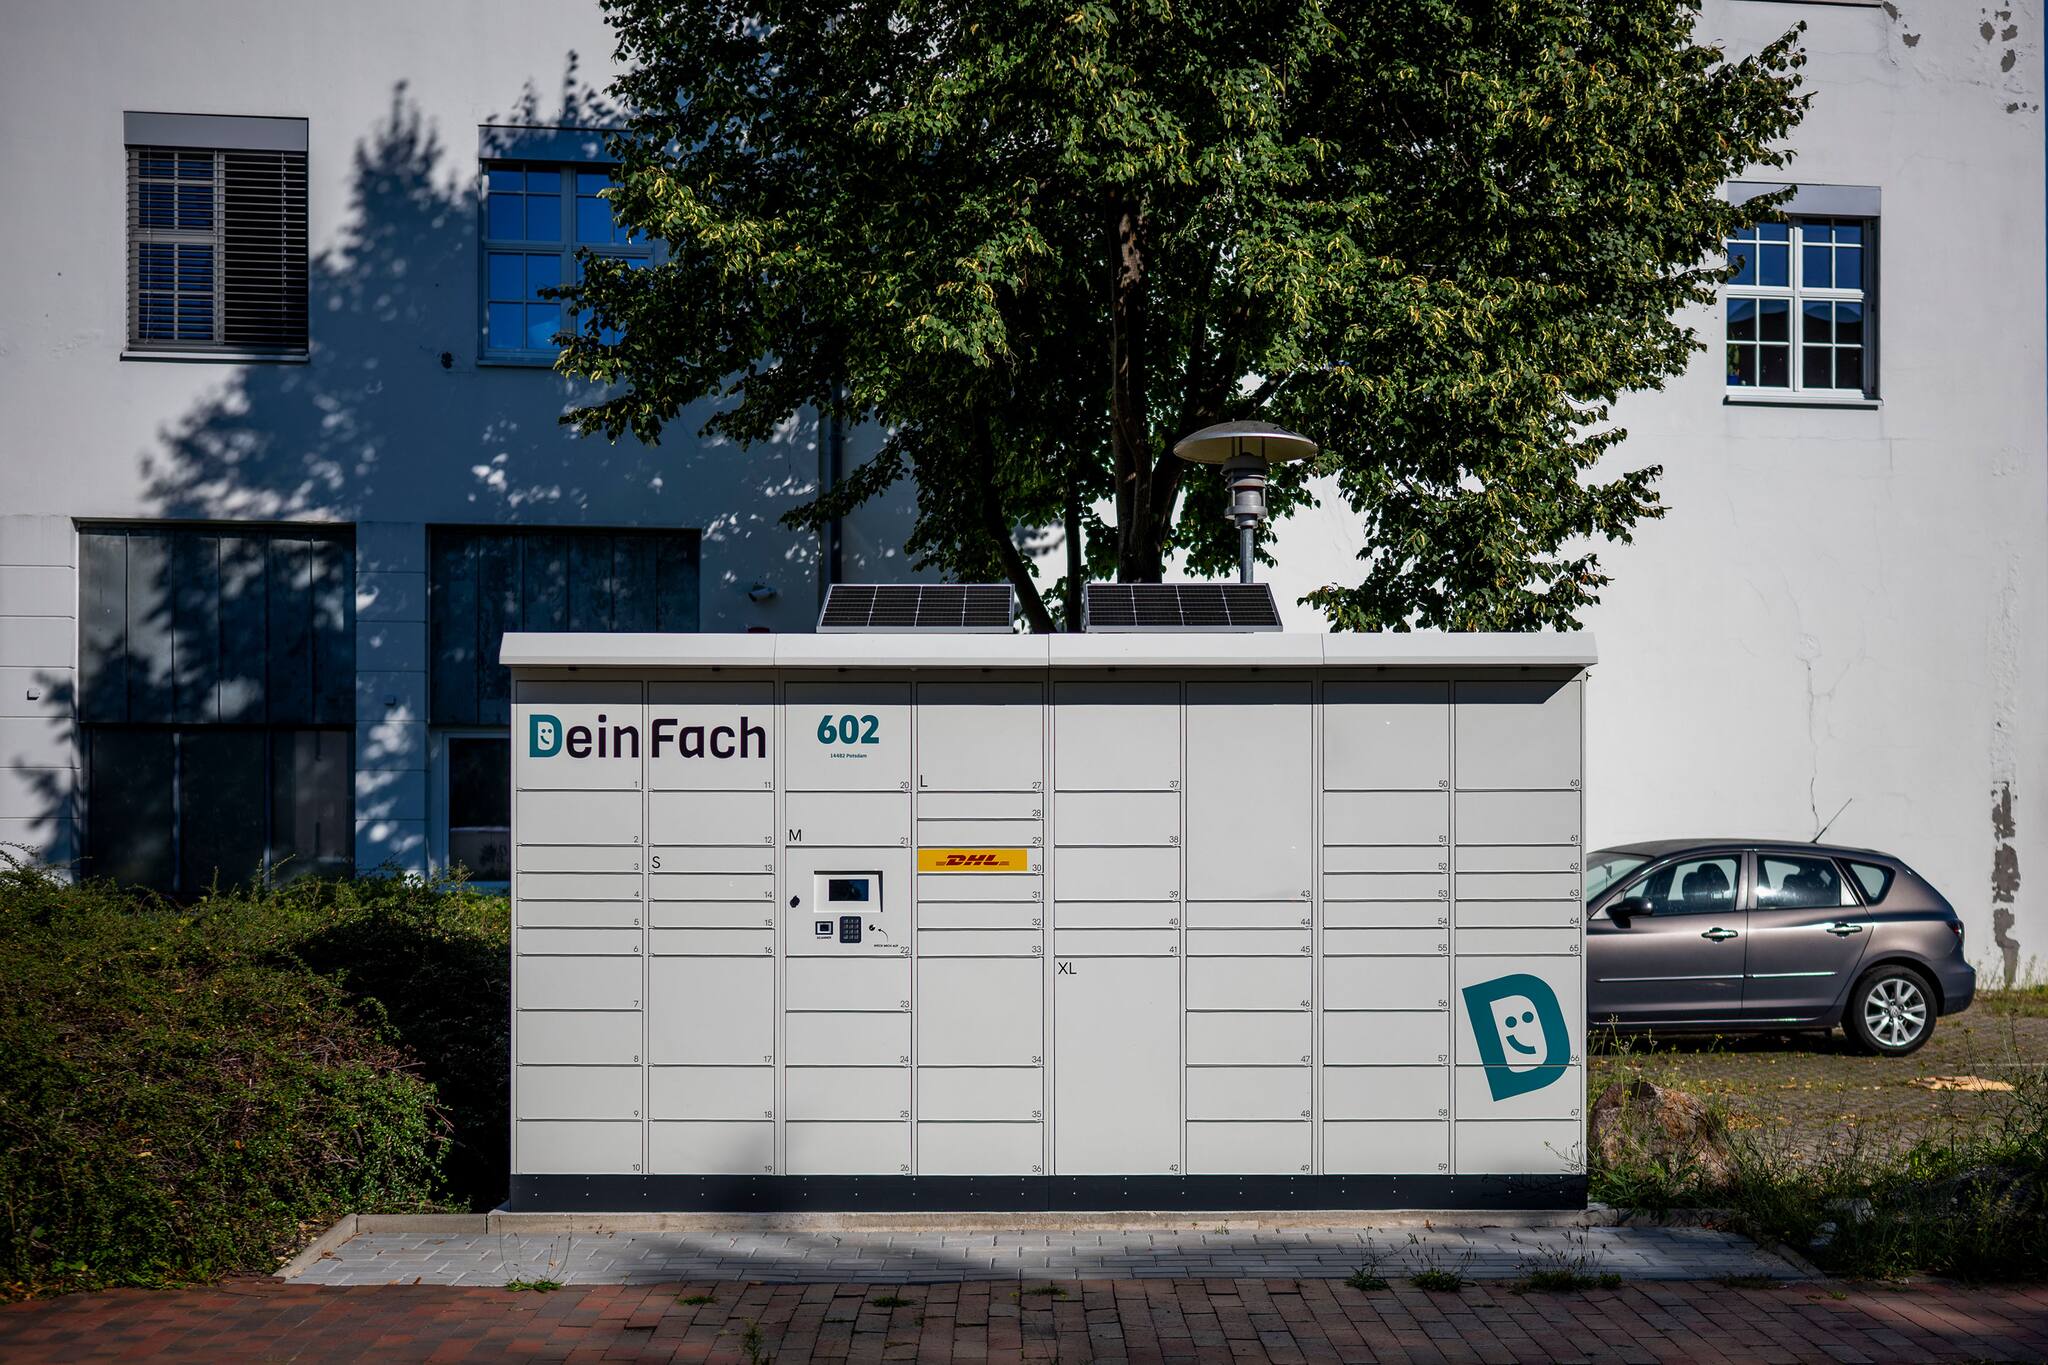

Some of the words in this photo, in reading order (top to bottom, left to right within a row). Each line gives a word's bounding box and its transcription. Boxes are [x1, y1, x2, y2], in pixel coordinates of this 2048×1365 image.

[816, 714, 880, 744] 602
[633, 780, 637, 788] 1
[764, 780, 771, 788] 11
[920, 774, 928, 787] L
[1170, 780, 1179, 788] 37
[1439, 780, 1448, 788] 50
[1570, 778, 1579, 786] 60
[900, 781, 909, 789] 20
[1032, 781, 1041, 789] 27
[1032, 809, 1041, 817] 28
[633, 835, 638, 843] 2
[789, 829, 802, 842] M
[1169, 835, 1178, 843] 38
[1438, 834, 1446, 842] 51
[1570, 833, 1578, 841] 61
[765, 836, 773, 844] 12
[900, 837, 908, 845] 21
[1032, 837, 1041, 845] 29
[652, 856, 661, 869] S
[946, 855, 999, 866] DHL
[633, 862, 639, 870] 3
[764, 863, 772, 871] 13
[1033, 863, 1041, 871] 30
[1438, 862, 1447, 870] 52
[1570, 862, 1580, 871] 62
[633, 890, 639, 898] 4
[764, 890, 772, 898] 14
[1032, 890, 1040, 898] 31
[1169, 891, 1178, 899] 39
[1301, 889, 1310, 897] 43
[1438, 889, 1447, 897] 53
[1570, 888, 1579, 896] 63
[633, 917, 639, 925] 5
[765, 918, 773, 926] 15
[1032, 918, 1041, 926] 32
[1169, 917, 1178, 925] 40
[1301, 917, 1310, 925] 44
[1438, 918, 1447, 926] 54
[1570, 917, 1579, 925] 64
[633, 944, 638, 952] 6
[764, 945, 772, 953] 16
[900, 946, 910, 954] 22
[1032, 945, 1041, 953] 33
[1169, 944, 1177, 952] 41
[1301, 945, 1310, 953] 45
[1438, 943, 1447, 951] 55
[1570, 944, 1579, 952] 65
[1058, 962, 1077, 975] XL
[633, 999, 639, 1007] 7
[900, 1000, 909, 1008] 23
[1301, 999, 1310, 1007] 46
[1438, 999, 1447, 1007] 56
[1461, 973, 1571, 1102] D
[633, 1054, 639, 1062] 8
[764, 1055, 772, 1063] 17
[900, 1055, 909, 1063] 24
[1032, 1055, 1041, 1063] 34
[1301, 1055, 1310, 1063] 47
[1438, 1054, 1447, 1062] 57
[633, 1109, 639, 1117] 9
[764, 1110, 772, 1118] 18
[900, 1110, 909, 1118] 25
[1032, 1110, 1041, 1118] 35
[1301, 1109, 1310, 1117] 48
[1438, 1108, 1447, 1116] 58
[1570, 1108, 1579, 1116] 67
[632, 1163, 640, 1171] 10
[764, 1164, 772, 1172] 19
[900, 1163, 909, 1171] 26
[1032, 1164, 1041, 1172] 36
[1169, 1163, 1178, 1171] 42
[1301, 1163, 1310, 1171] 49
[1438, 1163, 1447, 1172] 59
